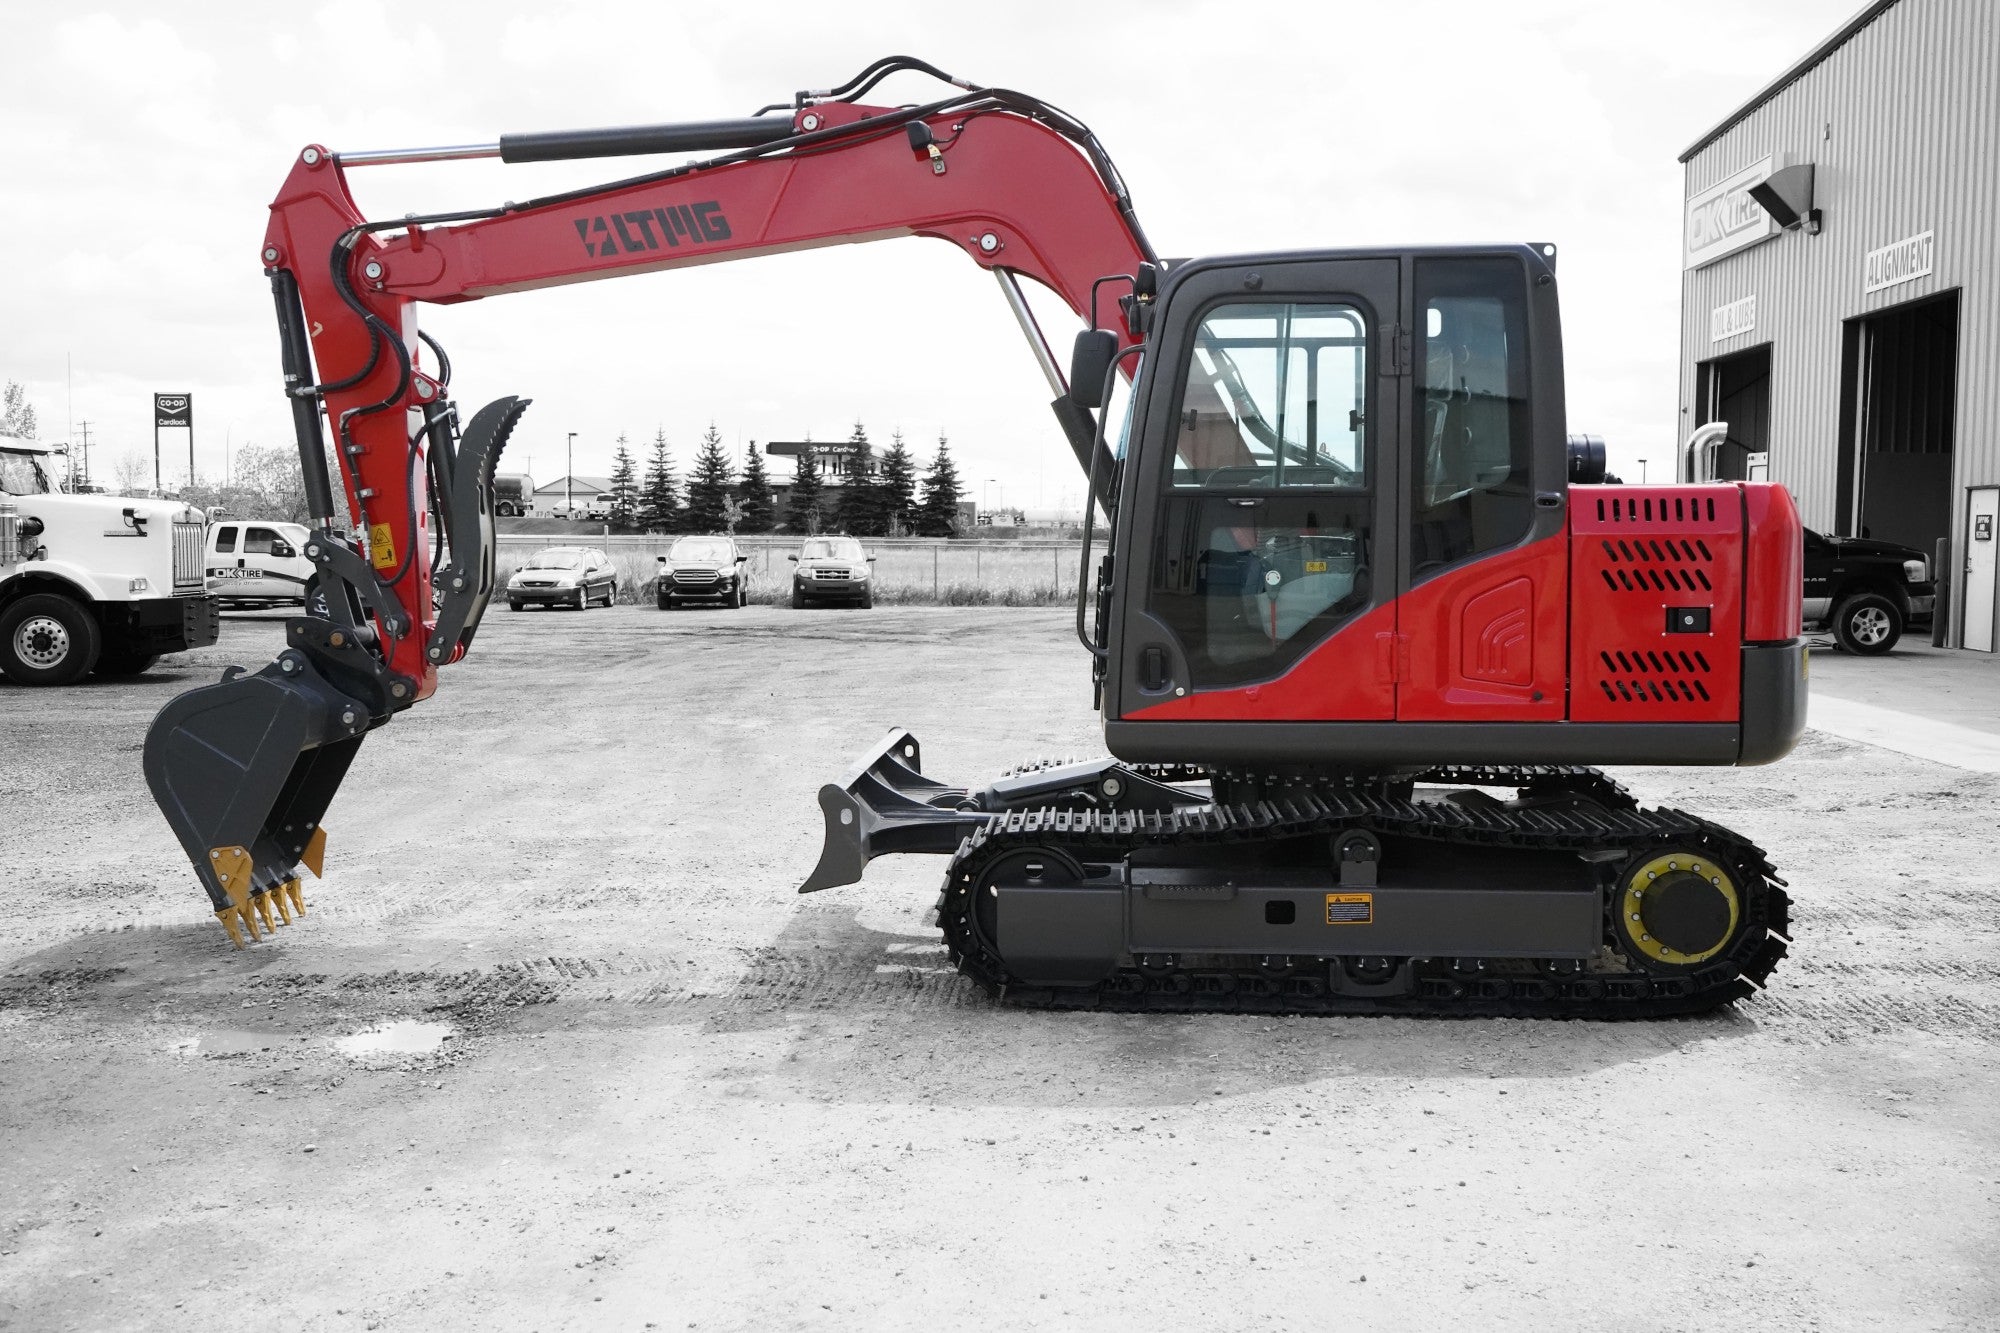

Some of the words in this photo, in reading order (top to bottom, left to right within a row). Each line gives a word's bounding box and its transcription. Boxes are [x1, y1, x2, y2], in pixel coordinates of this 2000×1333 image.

[1691, 199, 1721, 250] OK
[1727, 189, 1759, 229] TIRE
[1868, 236, 1931, 287] ALIGNMENT
[1714, 310, 1725, 337] OIL
[1727, 307, 1733, 332] &
[1734, 300, 1753, 330] LUBE
[160, 399, 184, 407] CO-OP
[158, 418, 187, 426] Cardlock
[215, 569, 237, 578] OK
[240, 570, 262, 578] TIRE
